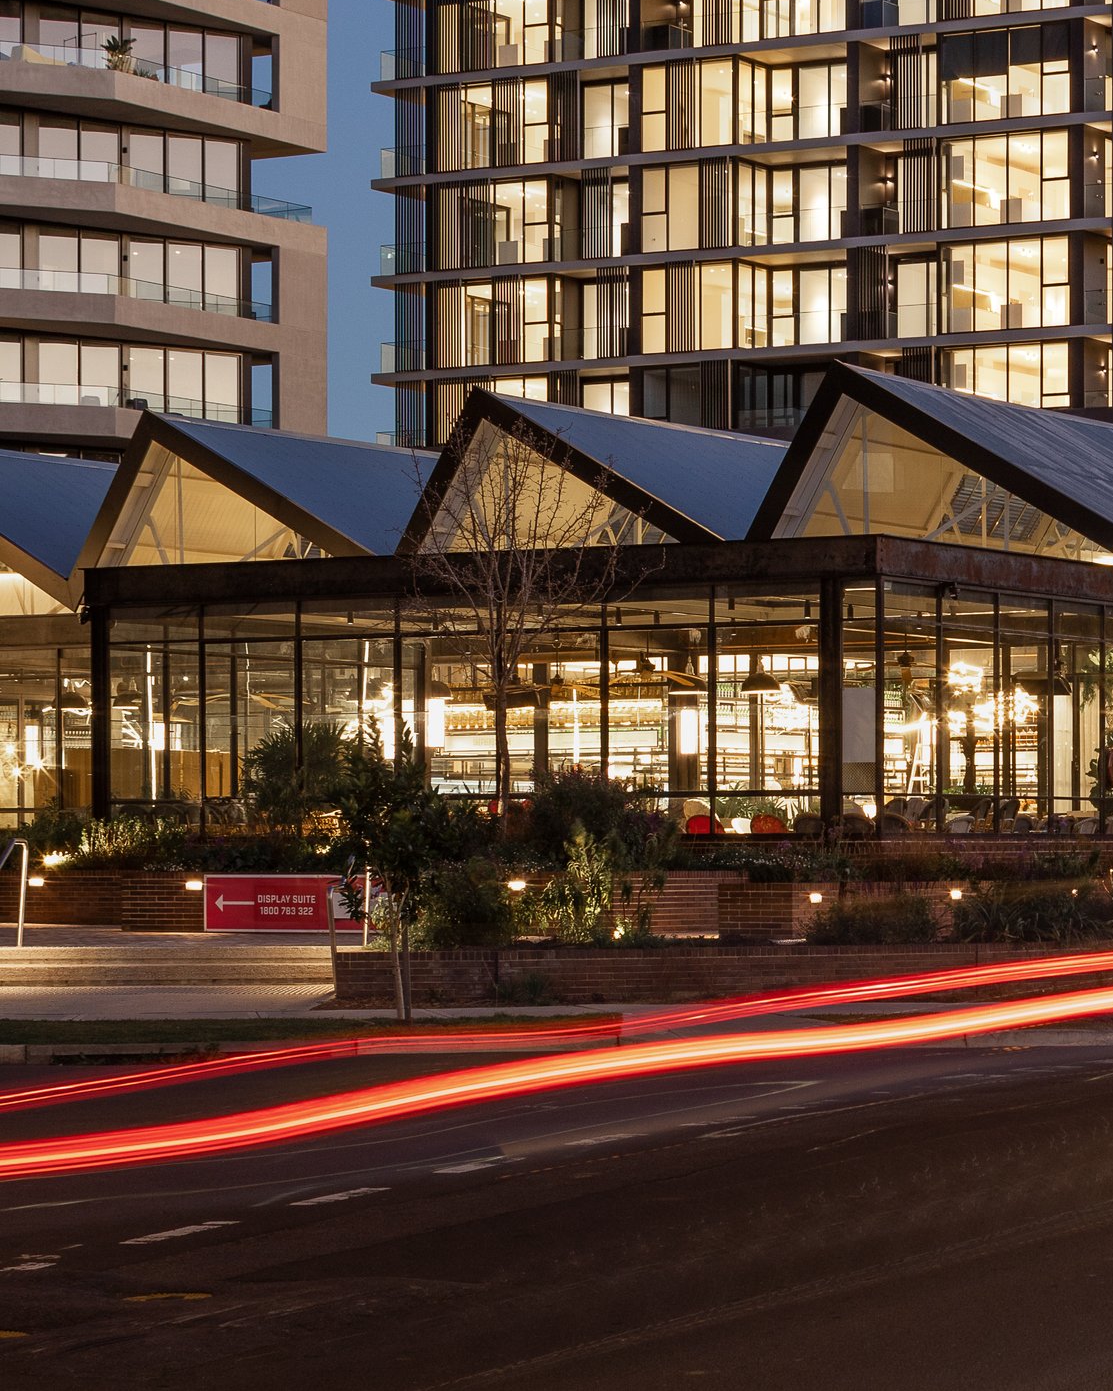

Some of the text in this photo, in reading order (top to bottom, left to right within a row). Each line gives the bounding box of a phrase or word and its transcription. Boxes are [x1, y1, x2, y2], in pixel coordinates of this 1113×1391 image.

[257, 894, 316, 903] DISPLAY SUITE
[260, 906, 313, 915] 1800 783 322
